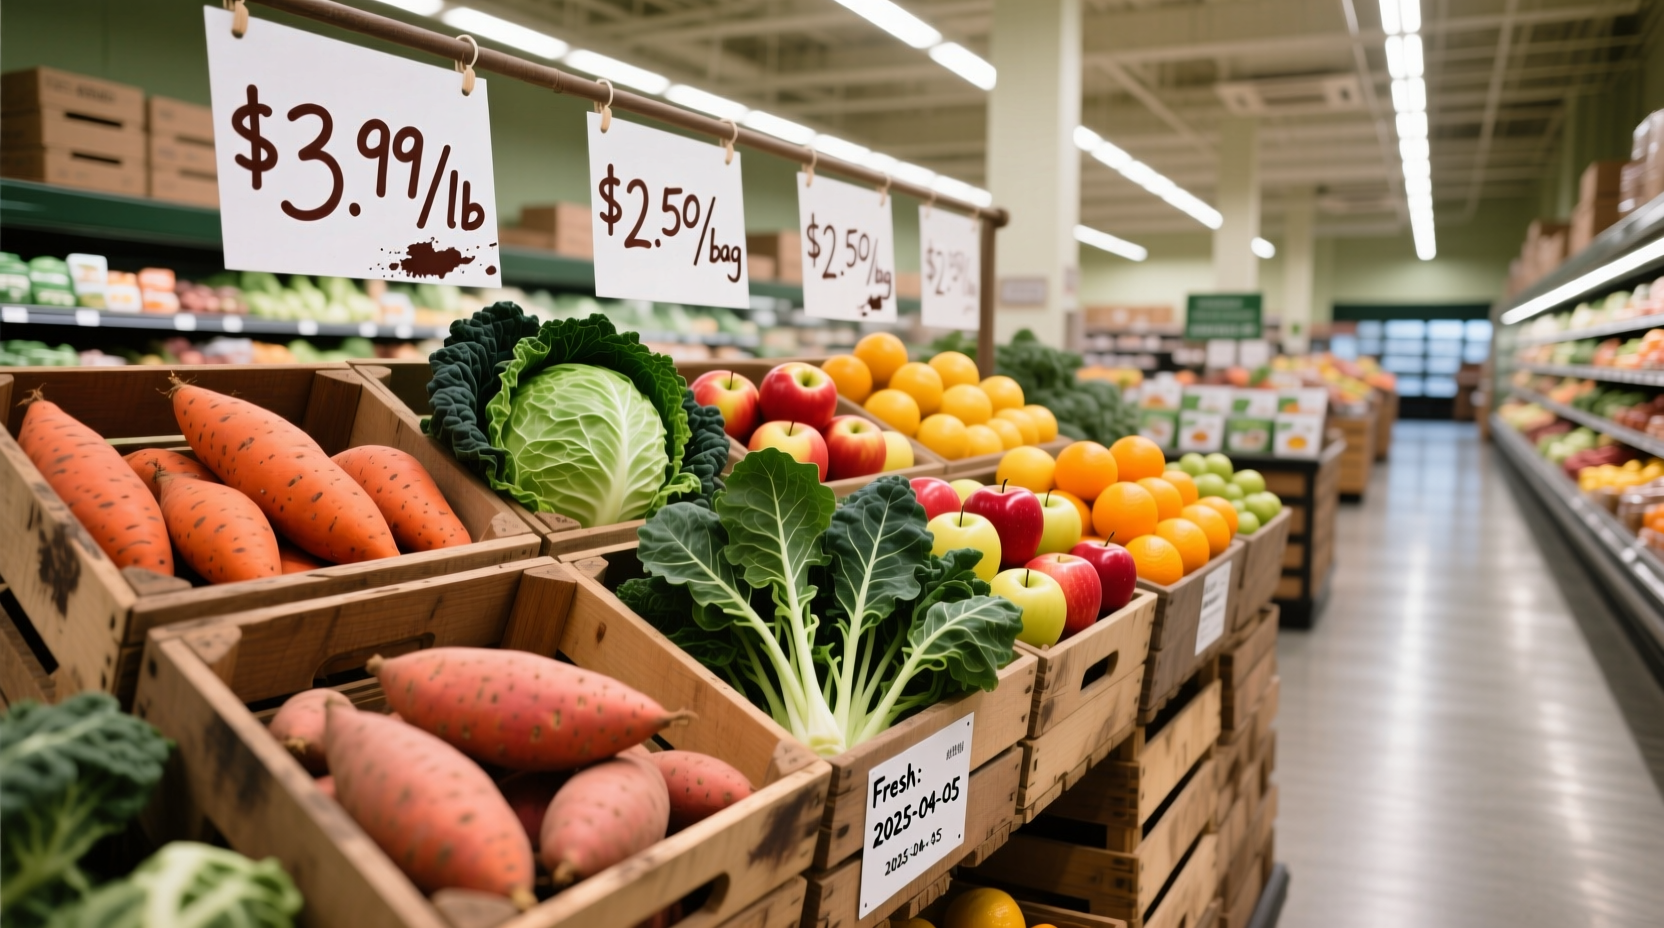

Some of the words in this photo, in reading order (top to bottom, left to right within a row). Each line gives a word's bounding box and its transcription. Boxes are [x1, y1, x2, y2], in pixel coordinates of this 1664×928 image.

[231, 83, 486, 232] $3.99/lb
[598, 163, 742, 283] $2.50/bag
[872, 763, 922, 809] Fresh:
[872, 775, 961, 850] 2025-04-05
